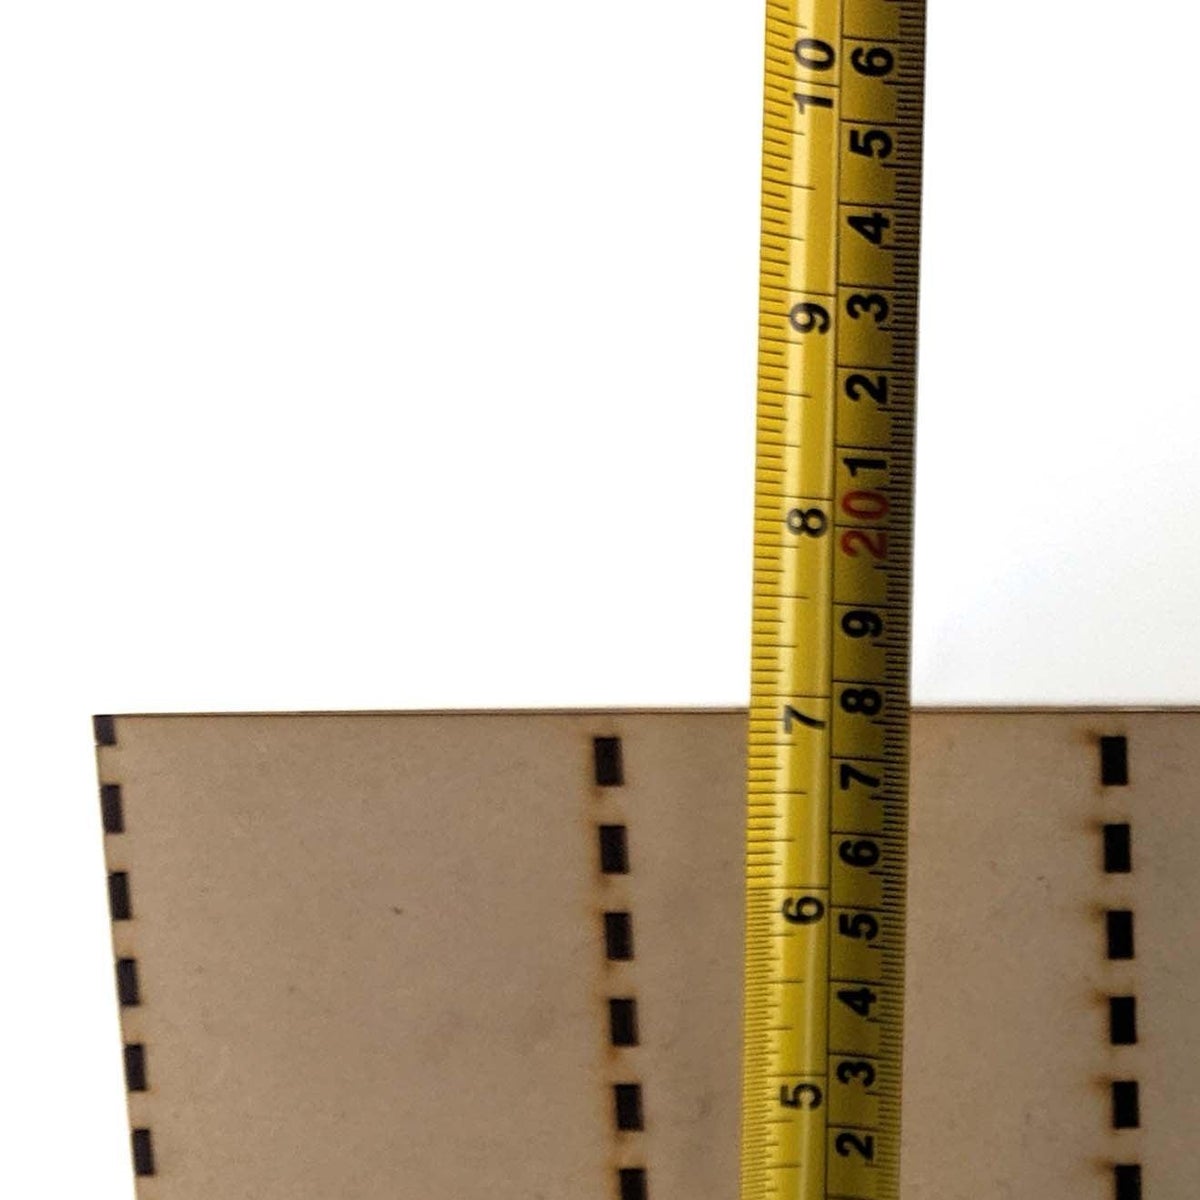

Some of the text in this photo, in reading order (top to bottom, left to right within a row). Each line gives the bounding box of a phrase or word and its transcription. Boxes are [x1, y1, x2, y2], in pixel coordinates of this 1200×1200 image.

[792, 38, 836, 114] 10
[850, 47, 894, 77] 6
[849, 130, 893, 159] 5
[847, 213, 890, 245] 4
[789, 302, 831, 335] 9
[846, 294, 889, 323] 3
[845, 373, 887, 405] 2
[843, 457, 887, 477] 1
[786, 508, 828, 538] 8
[840, 490, 890, 559] 20
[841, 610, 884, 639] 9
[840, 688, 882, 717] 8
[783, 705, 826, 734] 7
[840, 764, 880, 790] 7
[838, 839, 880, 868] 6
[782, 895, 825, 925] 6
[838, 913, 879, 941] 5
[836, 987, 877, 1017] 4
[836, 1061, 876, 1087] 3
[780, 1083, 823, 1112] 5
[835, 1132, 874, 1162] 2
